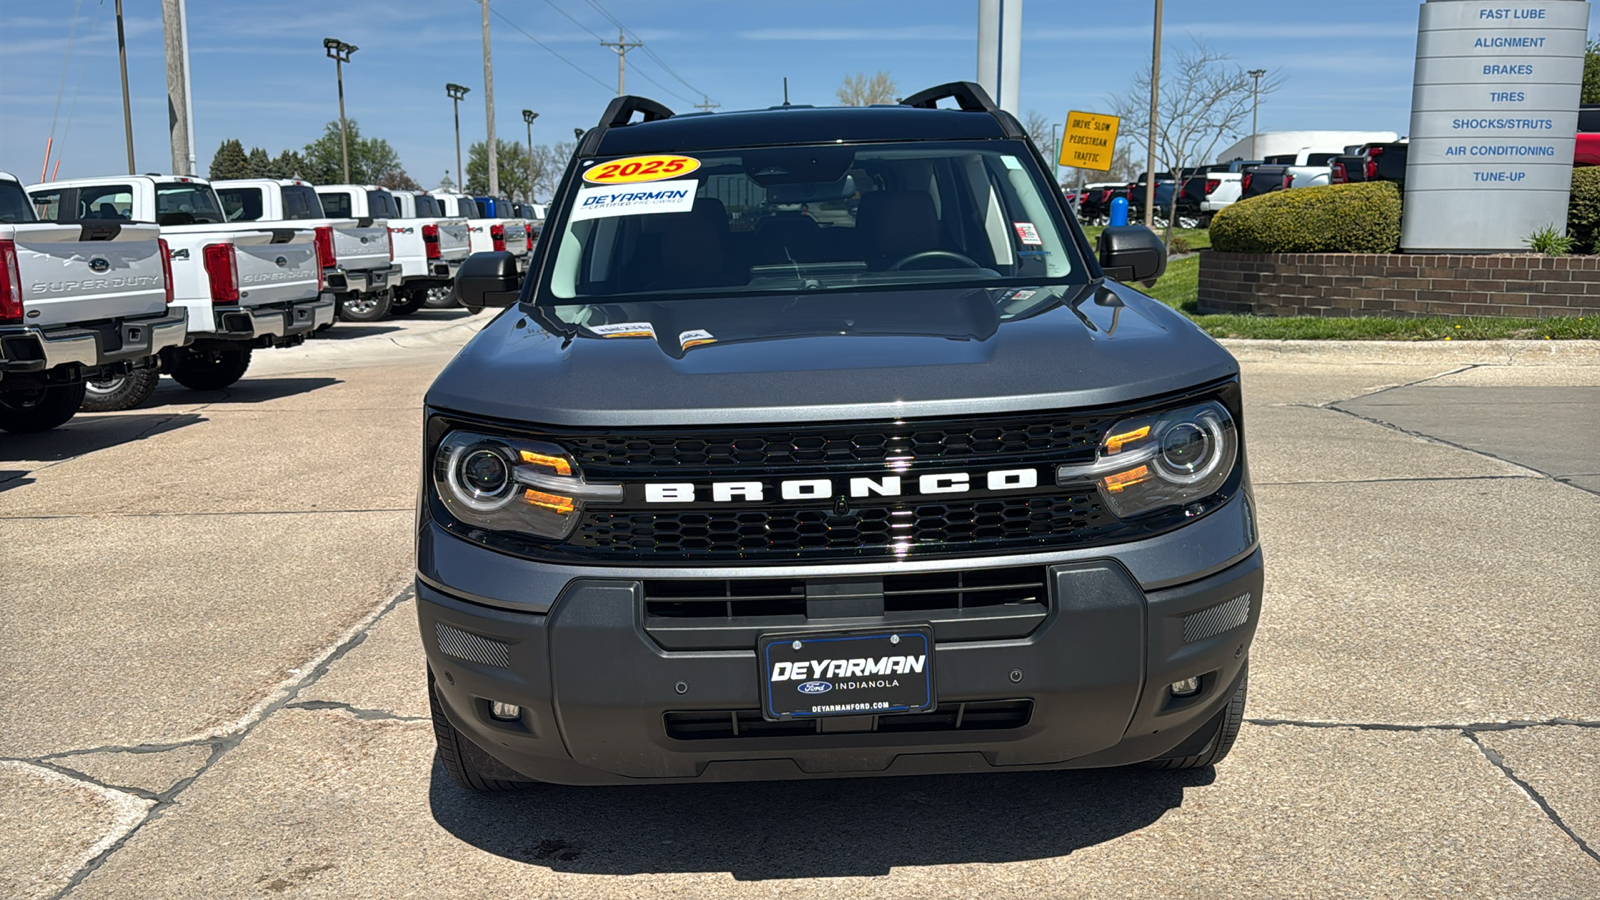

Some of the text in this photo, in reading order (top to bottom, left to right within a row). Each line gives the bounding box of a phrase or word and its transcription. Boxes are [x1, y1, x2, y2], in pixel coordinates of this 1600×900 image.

[1479, 9, 1546, 19] FAST LUBE
[1474, 37, 1546, 48] ALIGNMENT
[1482, 65, 1533, 75] BRAKES
[1490, 92, 1525, 102] TIRES
[1072, 119, 1111, 132] DRIVE SLOW
[1452, 119, 1553, 129] SHOCKS/STRUTS
[1069, 134, 1108, 147] PEDESTRIAN
[1073, 151, 1100, 162] TRAFFIC
[1445, 146, 1555, 156] AIR CONDITIONING
[594, 159, 688, 180] 2025
[1473, 172, 1526, 182] TUNE-UP
[582, 190, 689, 207] DEYARMAN
[588, 198, 684, 210] CERTIFIED PRE-OWNED
[243, 269, 316, 283] SUPER DUTY
[32, 275, 159, 294] SUPER DUTY
[644, 468, 1038, 503] BRONCO
[771, 655, 926, 682] DEYARMAN
[802, 679, 900, 693] Ford INDIANOLA
[812, 701, 889, 713] DEYARMANFORD.COM
